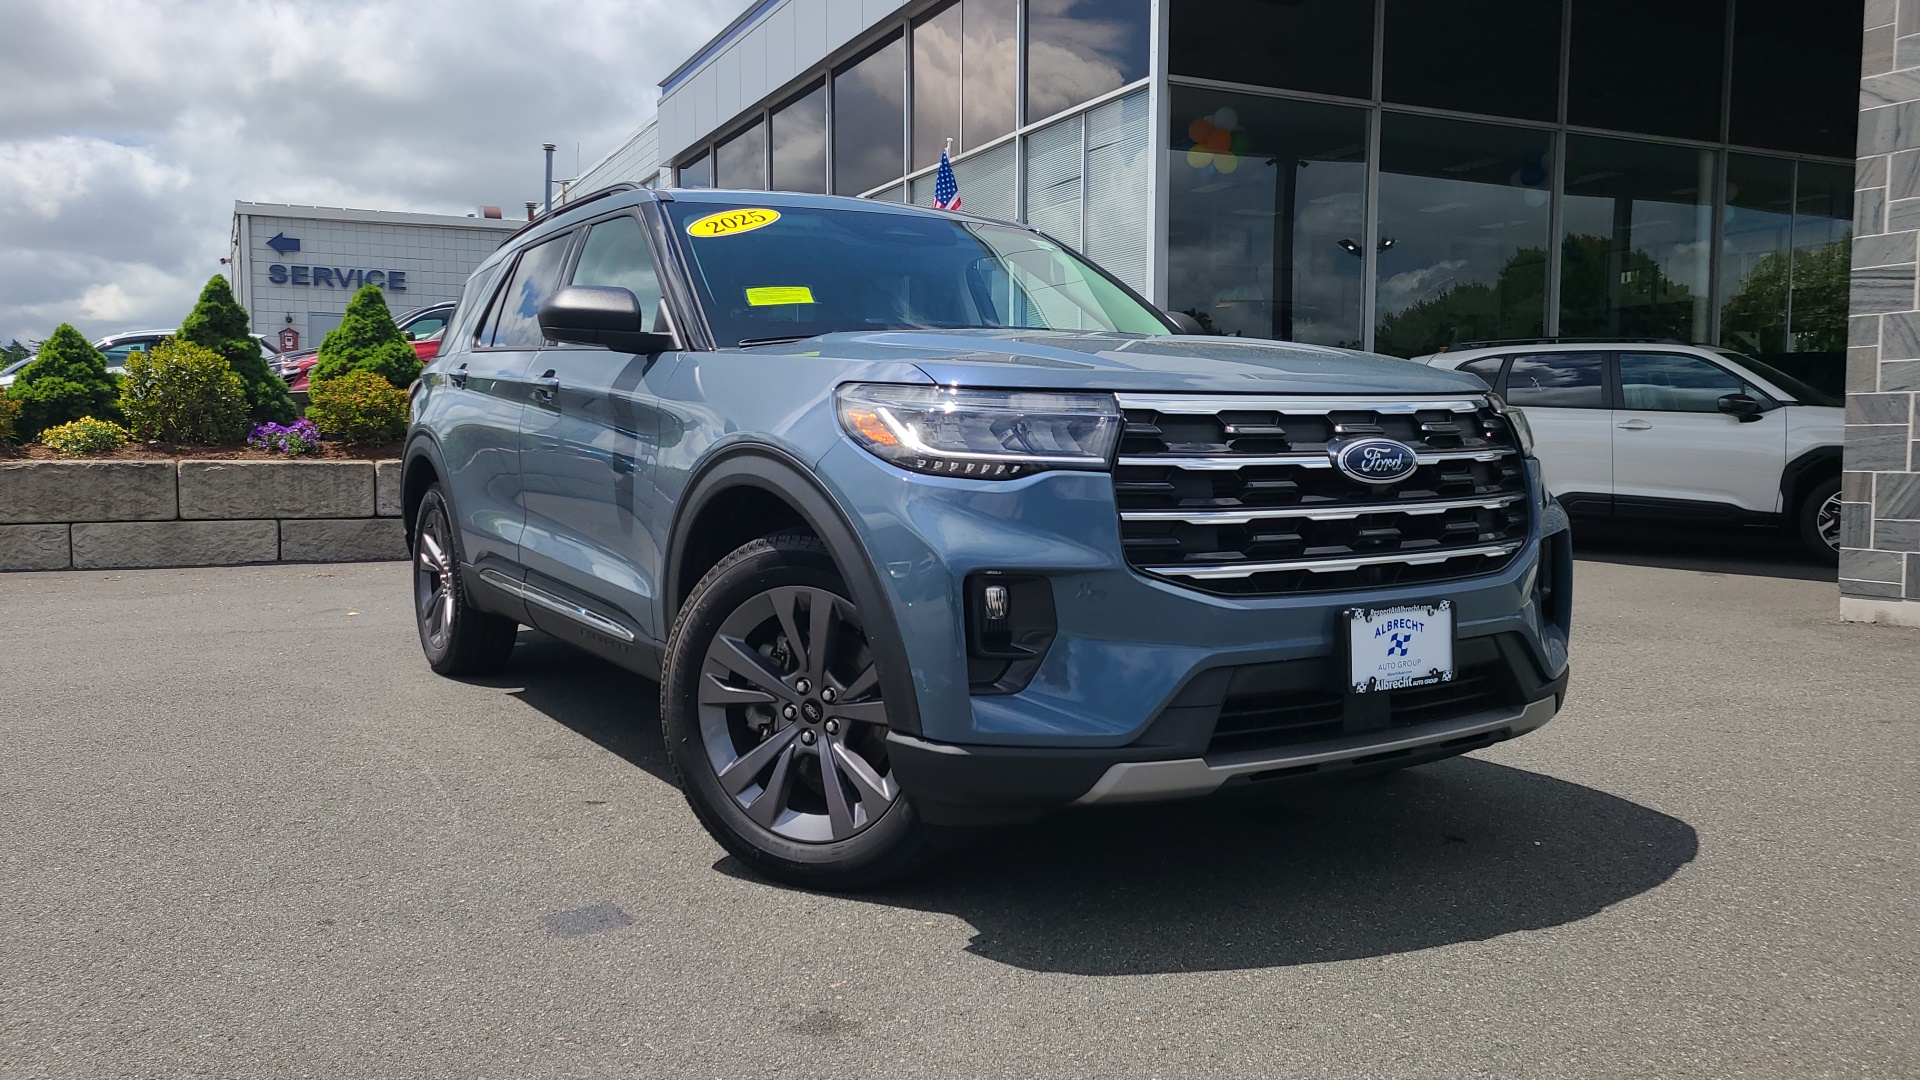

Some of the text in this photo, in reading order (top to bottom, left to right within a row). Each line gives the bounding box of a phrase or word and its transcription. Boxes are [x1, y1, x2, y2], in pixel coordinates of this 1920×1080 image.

[705, 211, 767, 234] 2025
[268, 264, 407, 291] SERVICE
[1361, 447, 1404, 473] Ford
[1374, 618, 1425, 639] ALBRECHT
[1378, 659, 1422, 671] AUTO GROUP
[1374, 676, 1413, 691] Albrecht
